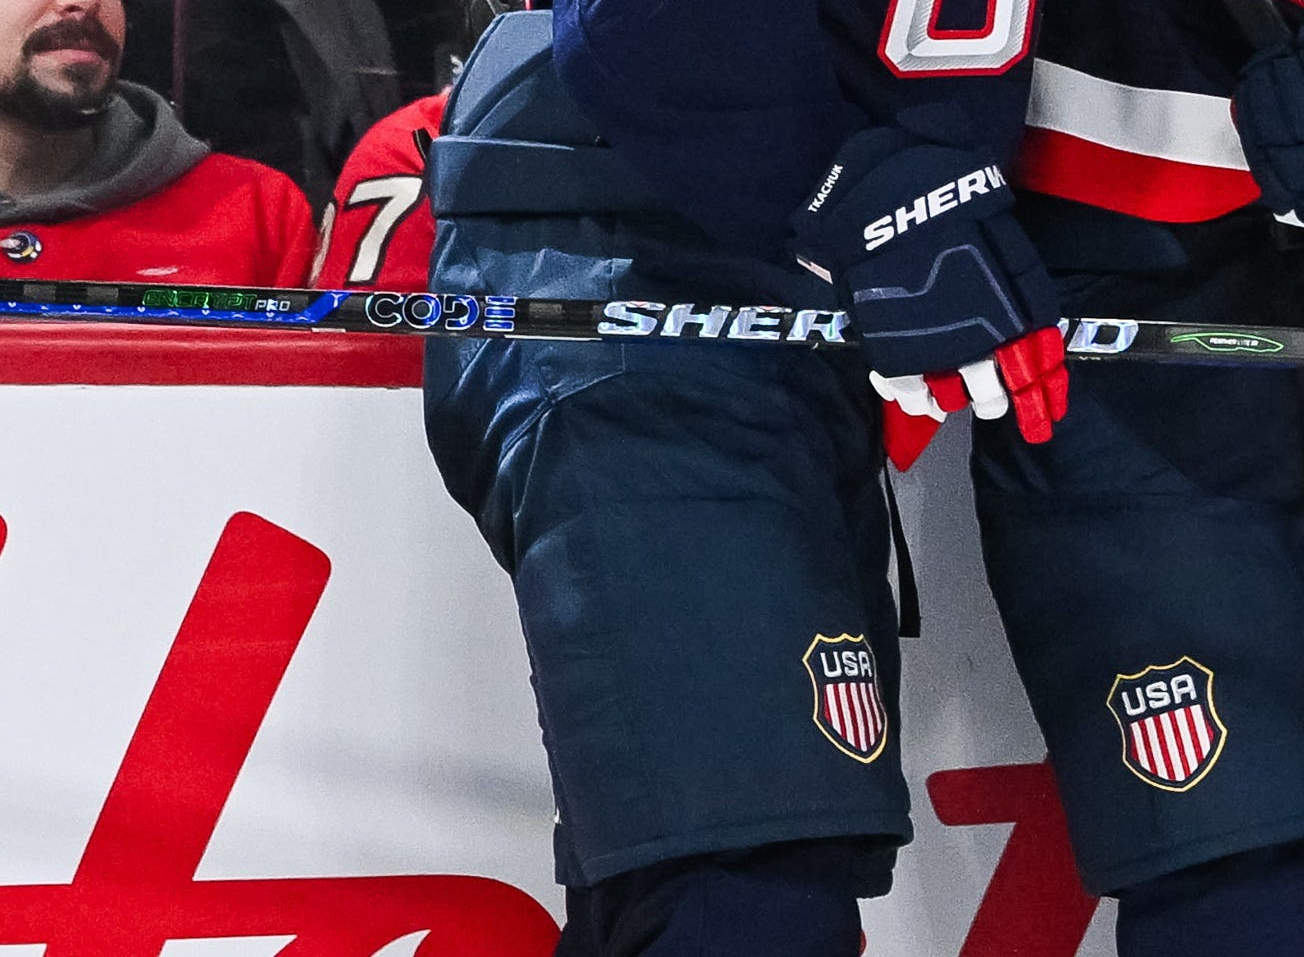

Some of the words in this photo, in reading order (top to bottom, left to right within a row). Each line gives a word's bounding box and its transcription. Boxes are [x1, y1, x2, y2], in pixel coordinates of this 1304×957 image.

[807, 163, 844, 213] TKACHUK
[254, 298, 291, 312] PRO
[365, 292, 518, 332] CODE
[820, 651, 873, 678] USA
[1121, 674, 1198, 717] USA
